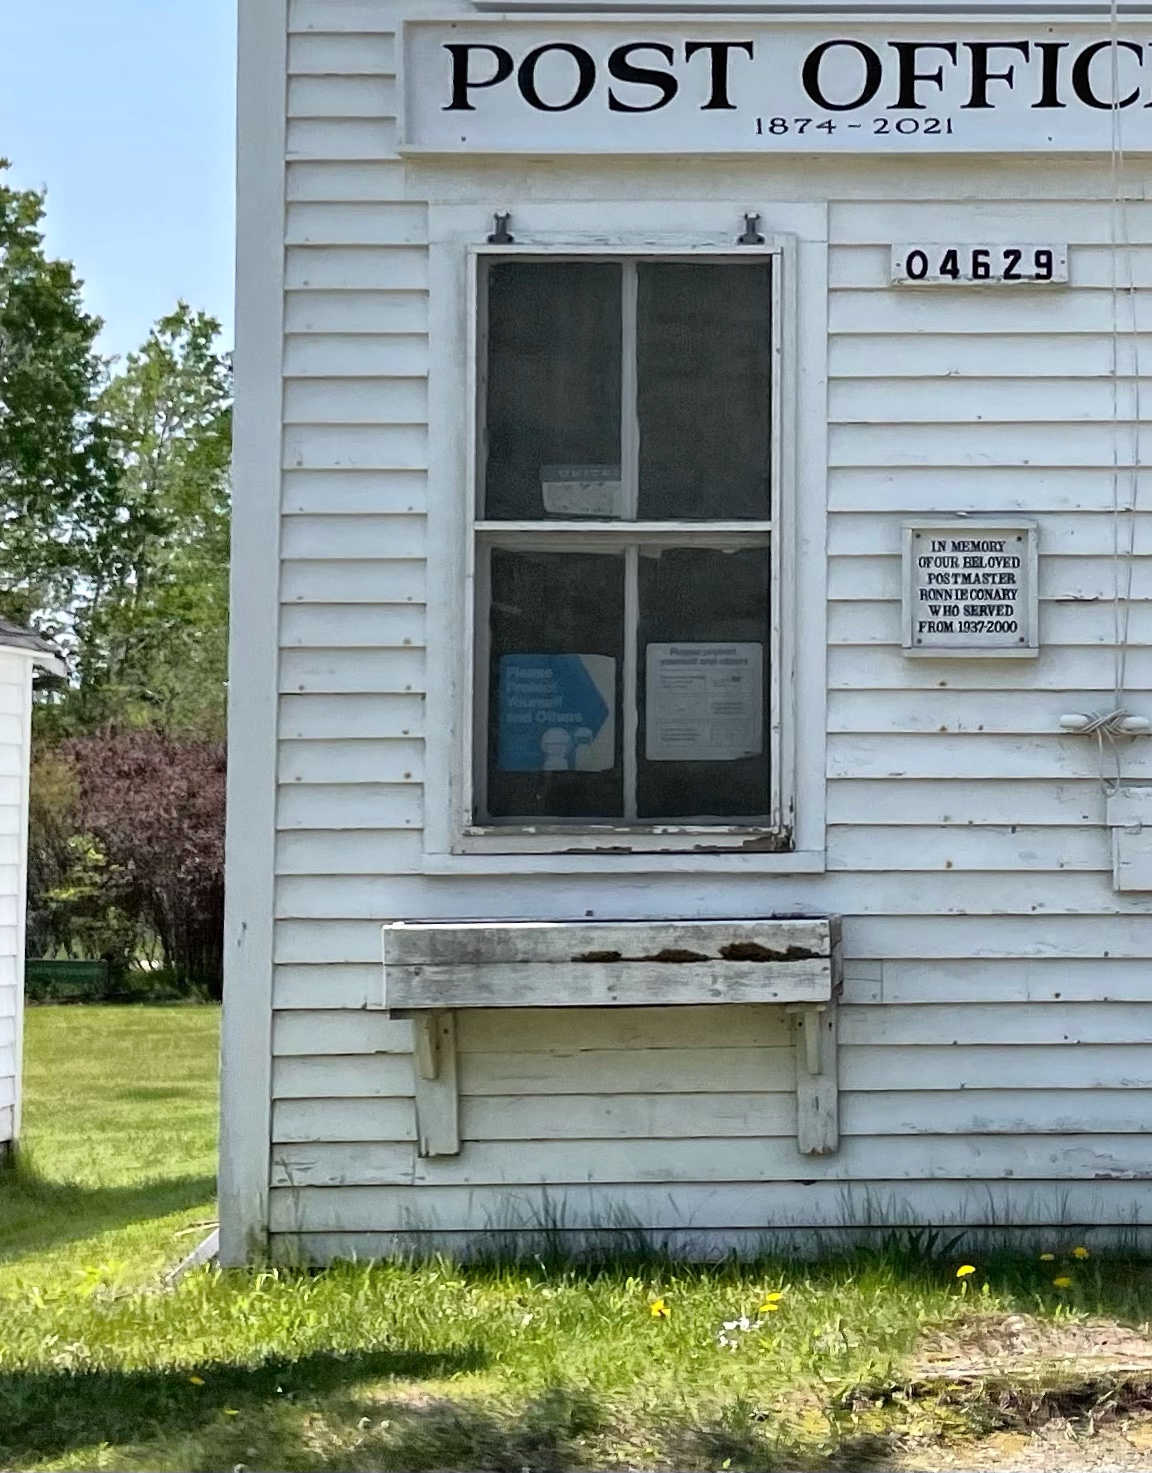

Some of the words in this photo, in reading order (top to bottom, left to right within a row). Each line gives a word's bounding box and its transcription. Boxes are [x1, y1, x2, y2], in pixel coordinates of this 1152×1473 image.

[442, 38, 755, 113] POST
[755, 116, 837, 136] 1874
[872, 116, 954, 136] 2021
[905, 248, 1054, 280] 04629
[931, 540, 947, 552] IN
[950, 540, 1006, 552] MEMORY
[963, 556, 1021, 568] BELOVED
[927, 572, 1017, 585] POSTMASTER
[919, 588, 968, 601] RONNIE
[969, 588, 1019, 601] CONARY
[928, 604, 960, 617] WHO
[963, 604, 1014, 617] SERVED
[918, 621, 954, 633] FROM
[958, 621, 1018, 633] 1937-2000
[506, 666, 553, 678] Please
